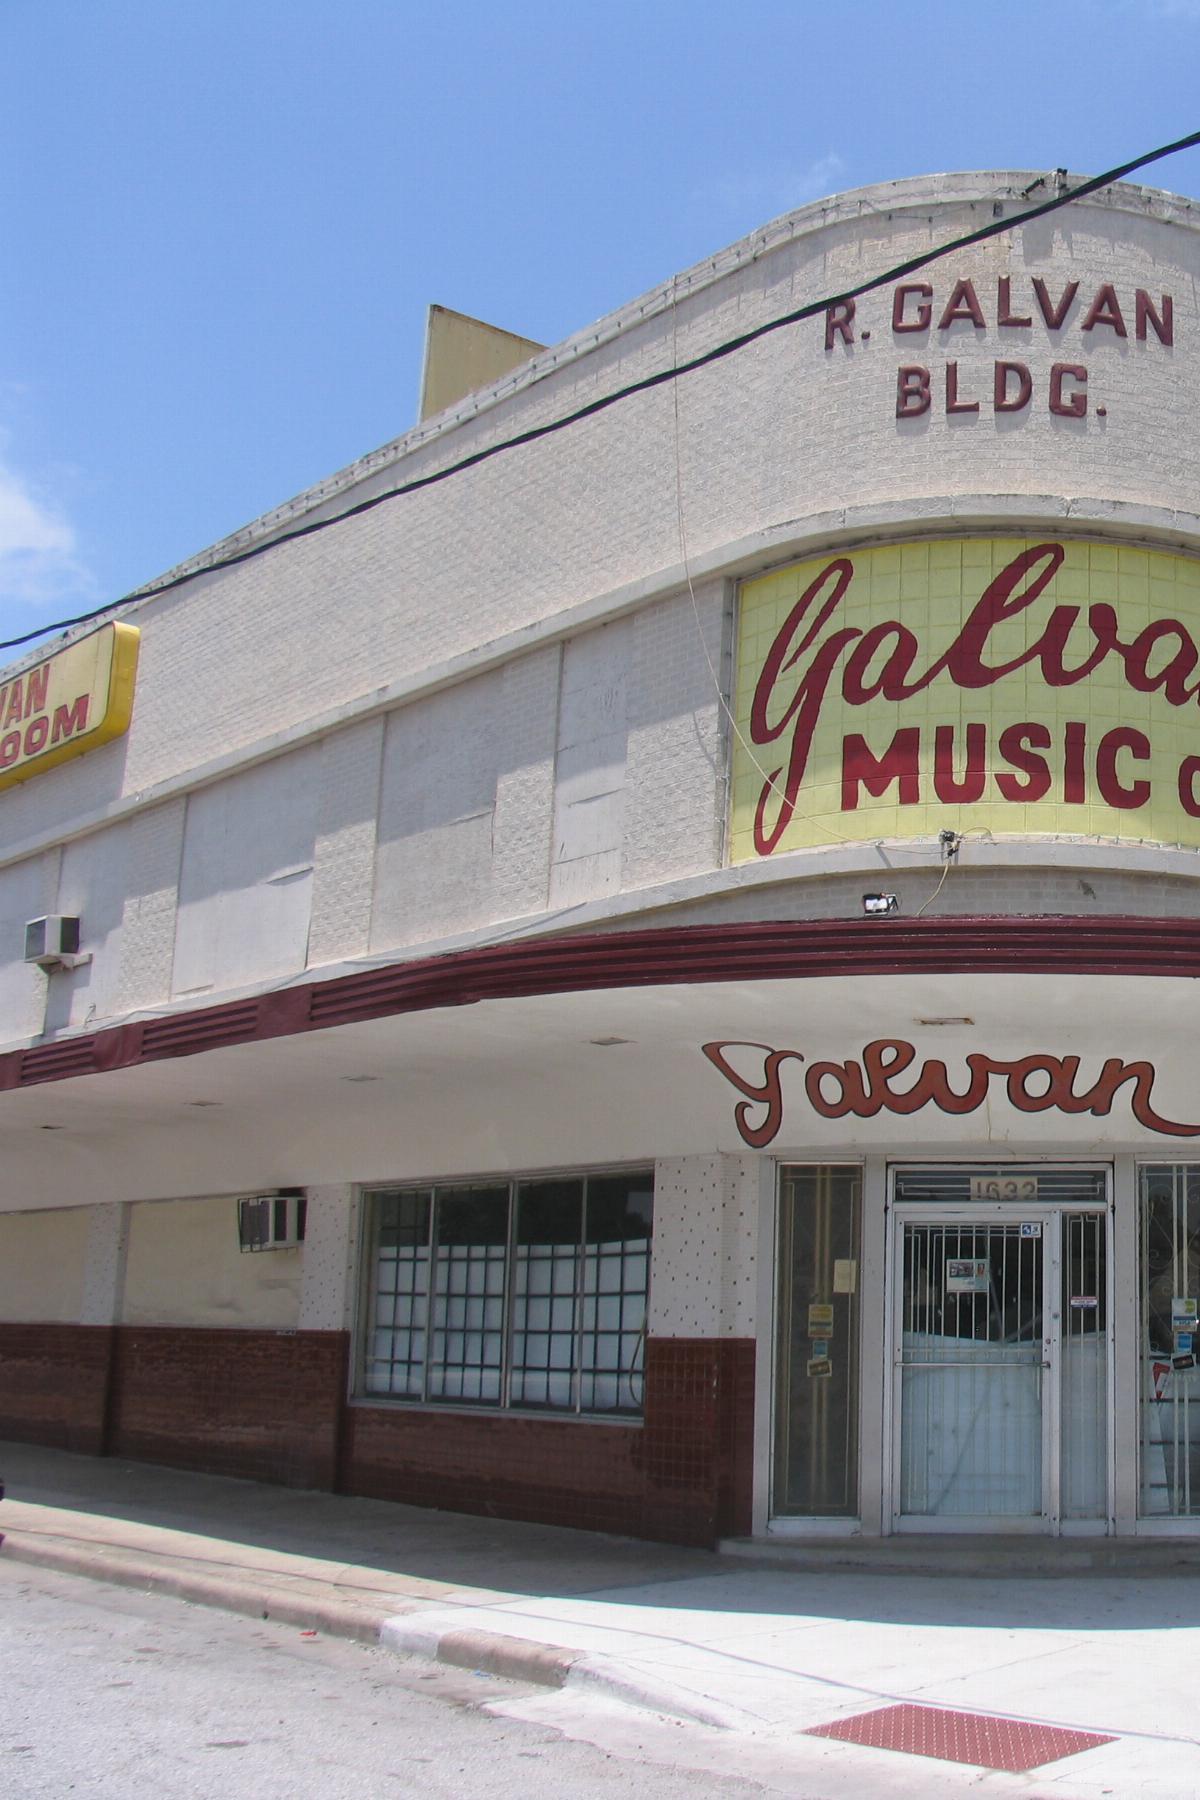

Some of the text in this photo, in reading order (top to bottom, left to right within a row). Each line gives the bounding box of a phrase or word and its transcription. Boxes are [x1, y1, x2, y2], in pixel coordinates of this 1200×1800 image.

[823, 274, 1174, 350] R. GALVAN
[896, 360, 1107, 418] BLDG.
[841, 721, 1151, 811] MUSIC
